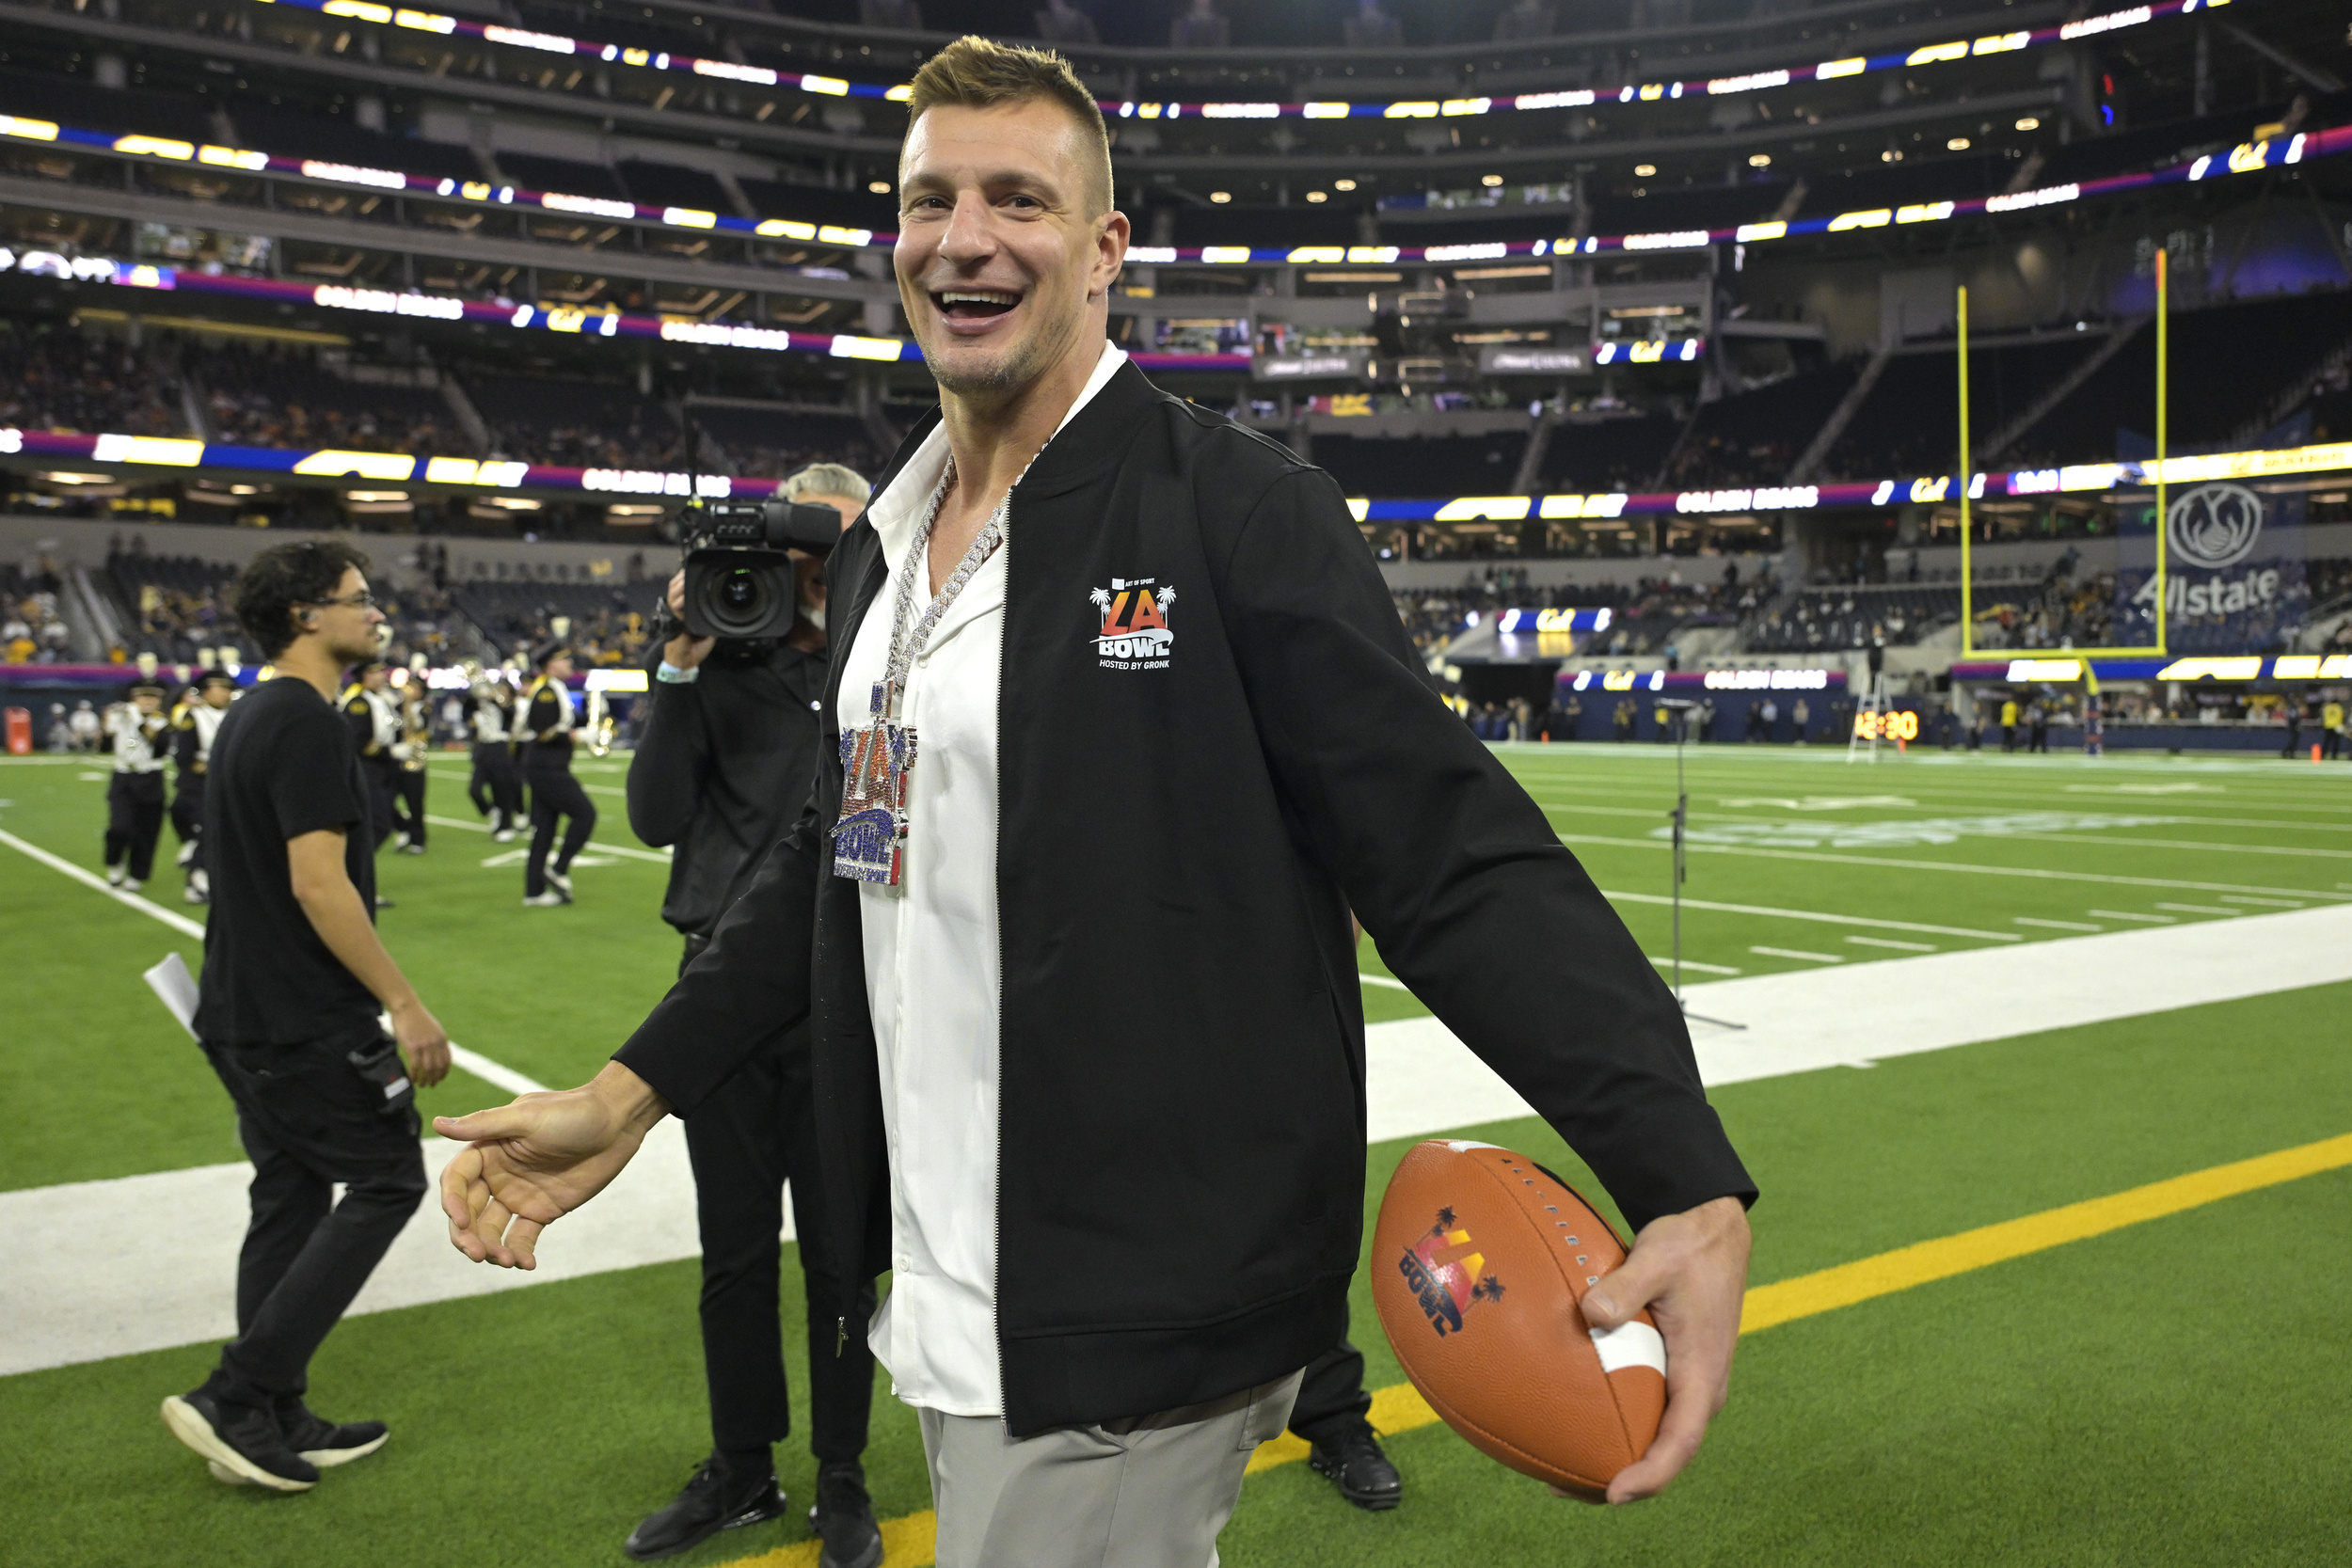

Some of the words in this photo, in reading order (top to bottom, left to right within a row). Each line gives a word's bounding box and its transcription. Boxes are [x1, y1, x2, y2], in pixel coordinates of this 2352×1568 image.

[1100, 589, 1168, 636] LA
[2132, 568, 2280, 617] Allstate
[1099, 637, 1169, 658] BOWL
[1099, 659, 1129, 670] HOSTED
[1131, 661, 1142, 670] BY
[1144, 660, 1169, 669] GRONK
[1854, 710, 1918, 740] 12:30
[1398, 1253, 1448, 1338] BOWL
[1414, 1228, 1486, 1317] LA
